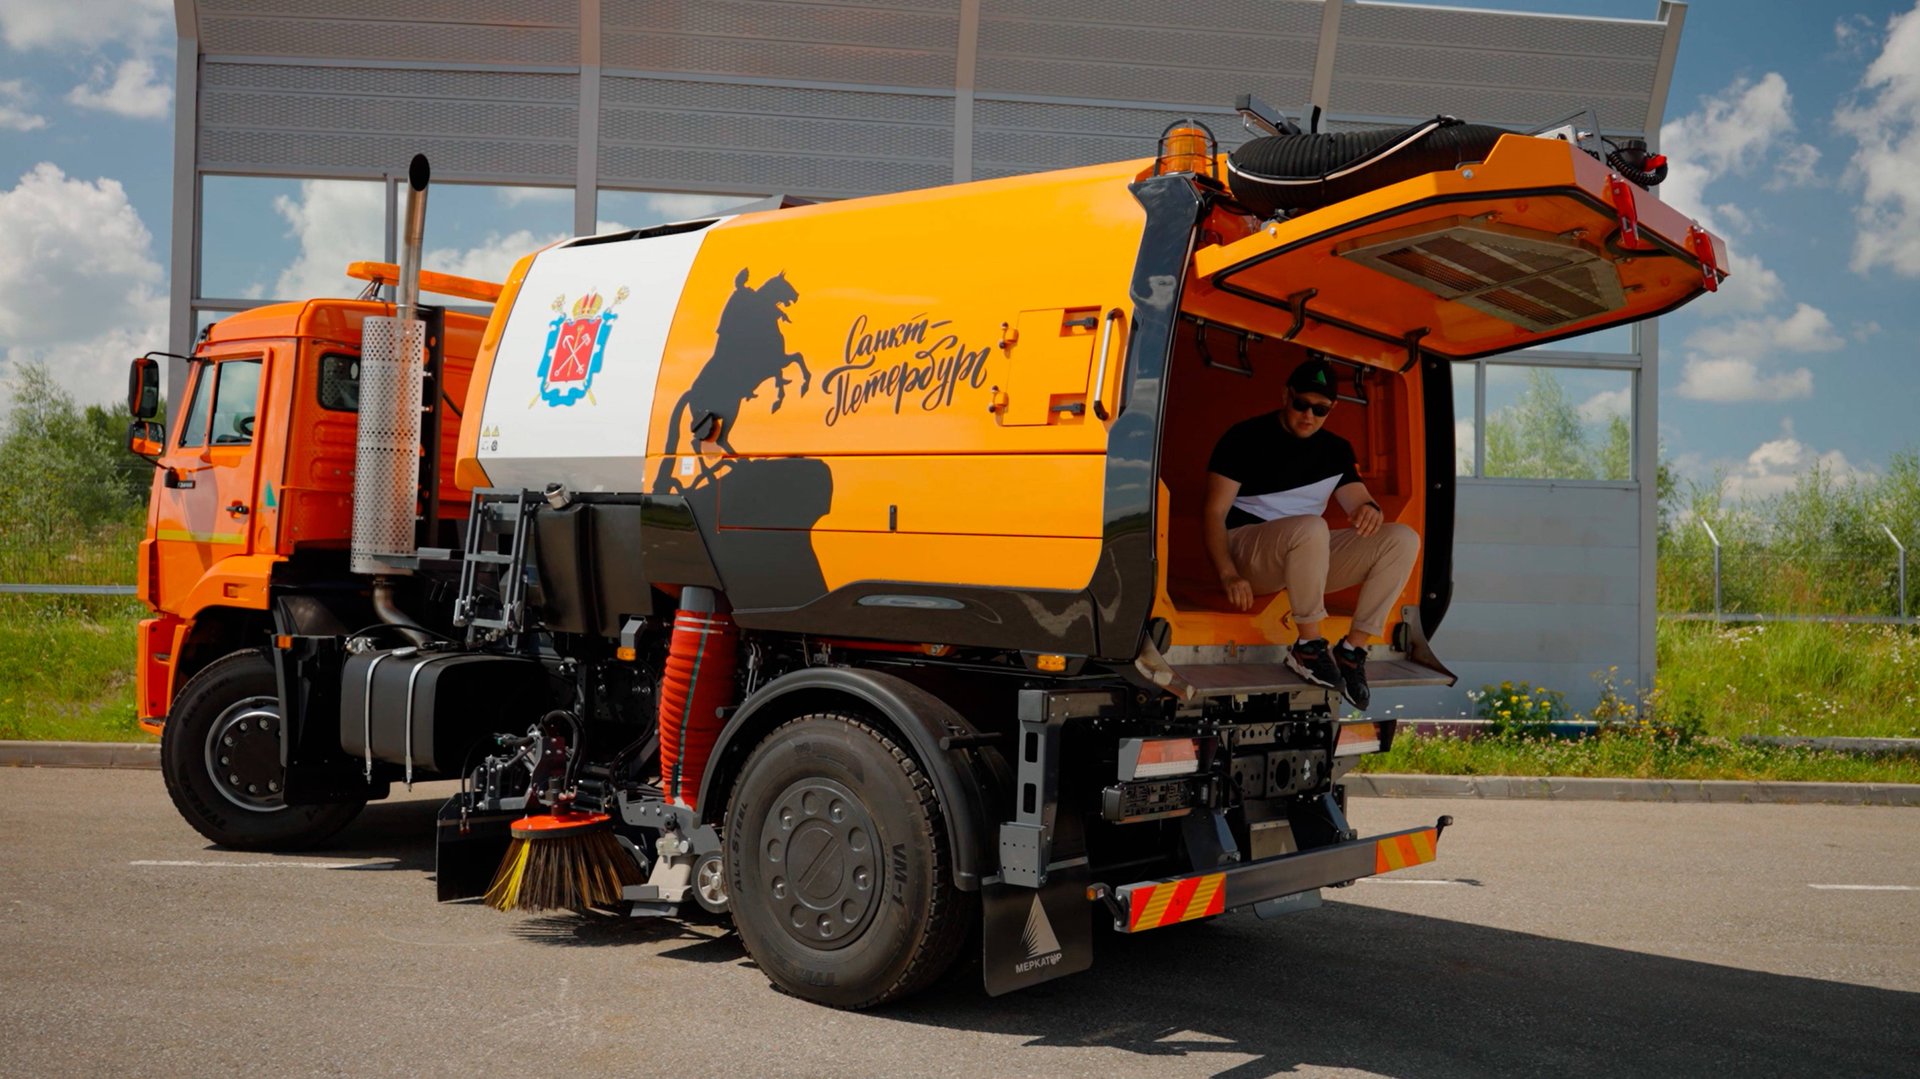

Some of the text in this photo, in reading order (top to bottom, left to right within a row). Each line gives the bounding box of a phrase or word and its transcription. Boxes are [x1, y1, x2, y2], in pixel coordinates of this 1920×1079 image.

[845, 312, 953, 365] Санкт-
[822, 335, 991, 427] Петербург
[892, 843, 908, 907] VM-1
